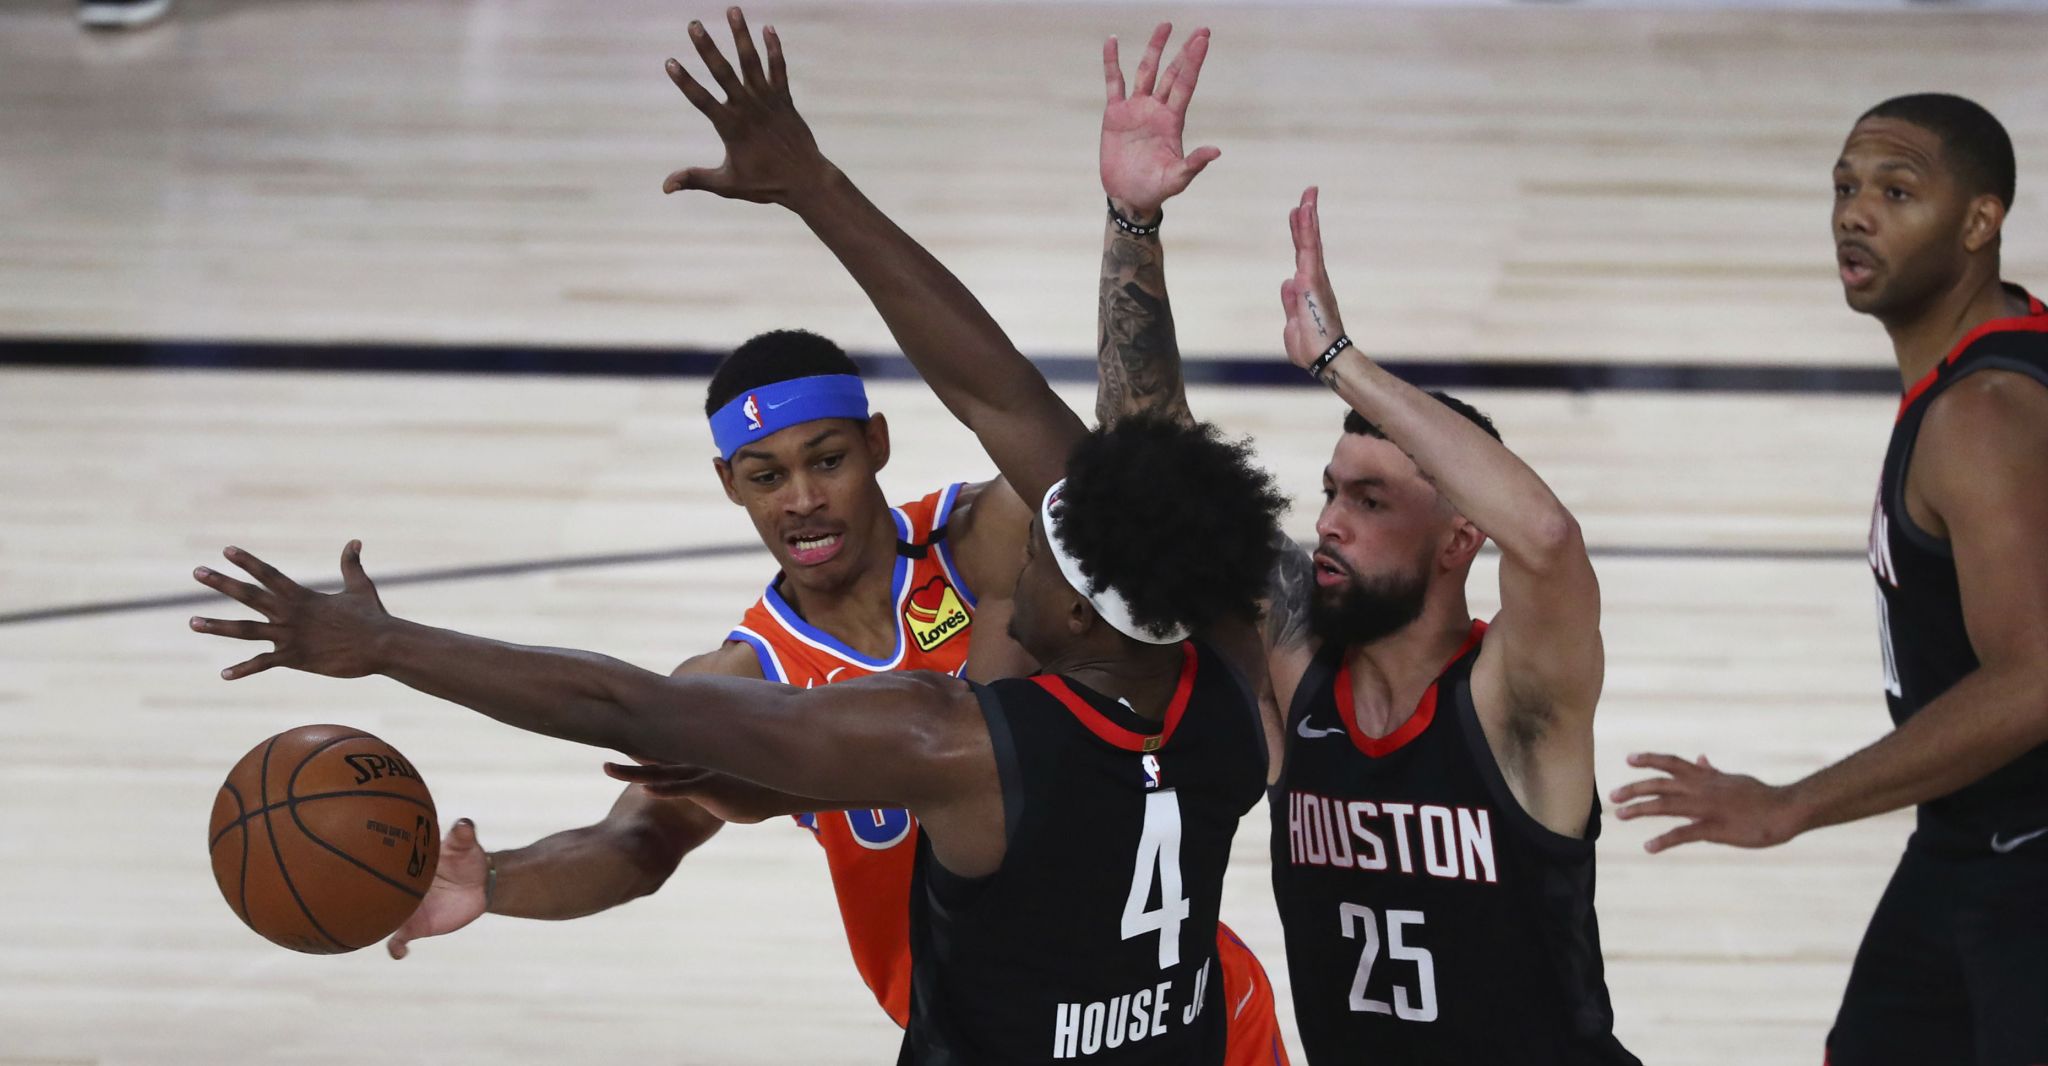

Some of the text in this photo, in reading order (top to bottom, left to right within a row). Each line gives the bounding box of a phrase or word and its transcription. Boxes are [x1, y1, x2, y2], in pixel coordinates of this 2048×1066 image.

[1324, 347, 1337, 362] AR
[1120, 787, 1191, 970] 4
[1288, 791, 1499, 884] HOUSTON
[1338, 901, 1439, 1023] 25
[1053, 981, 1173, 1059] HOUSE
